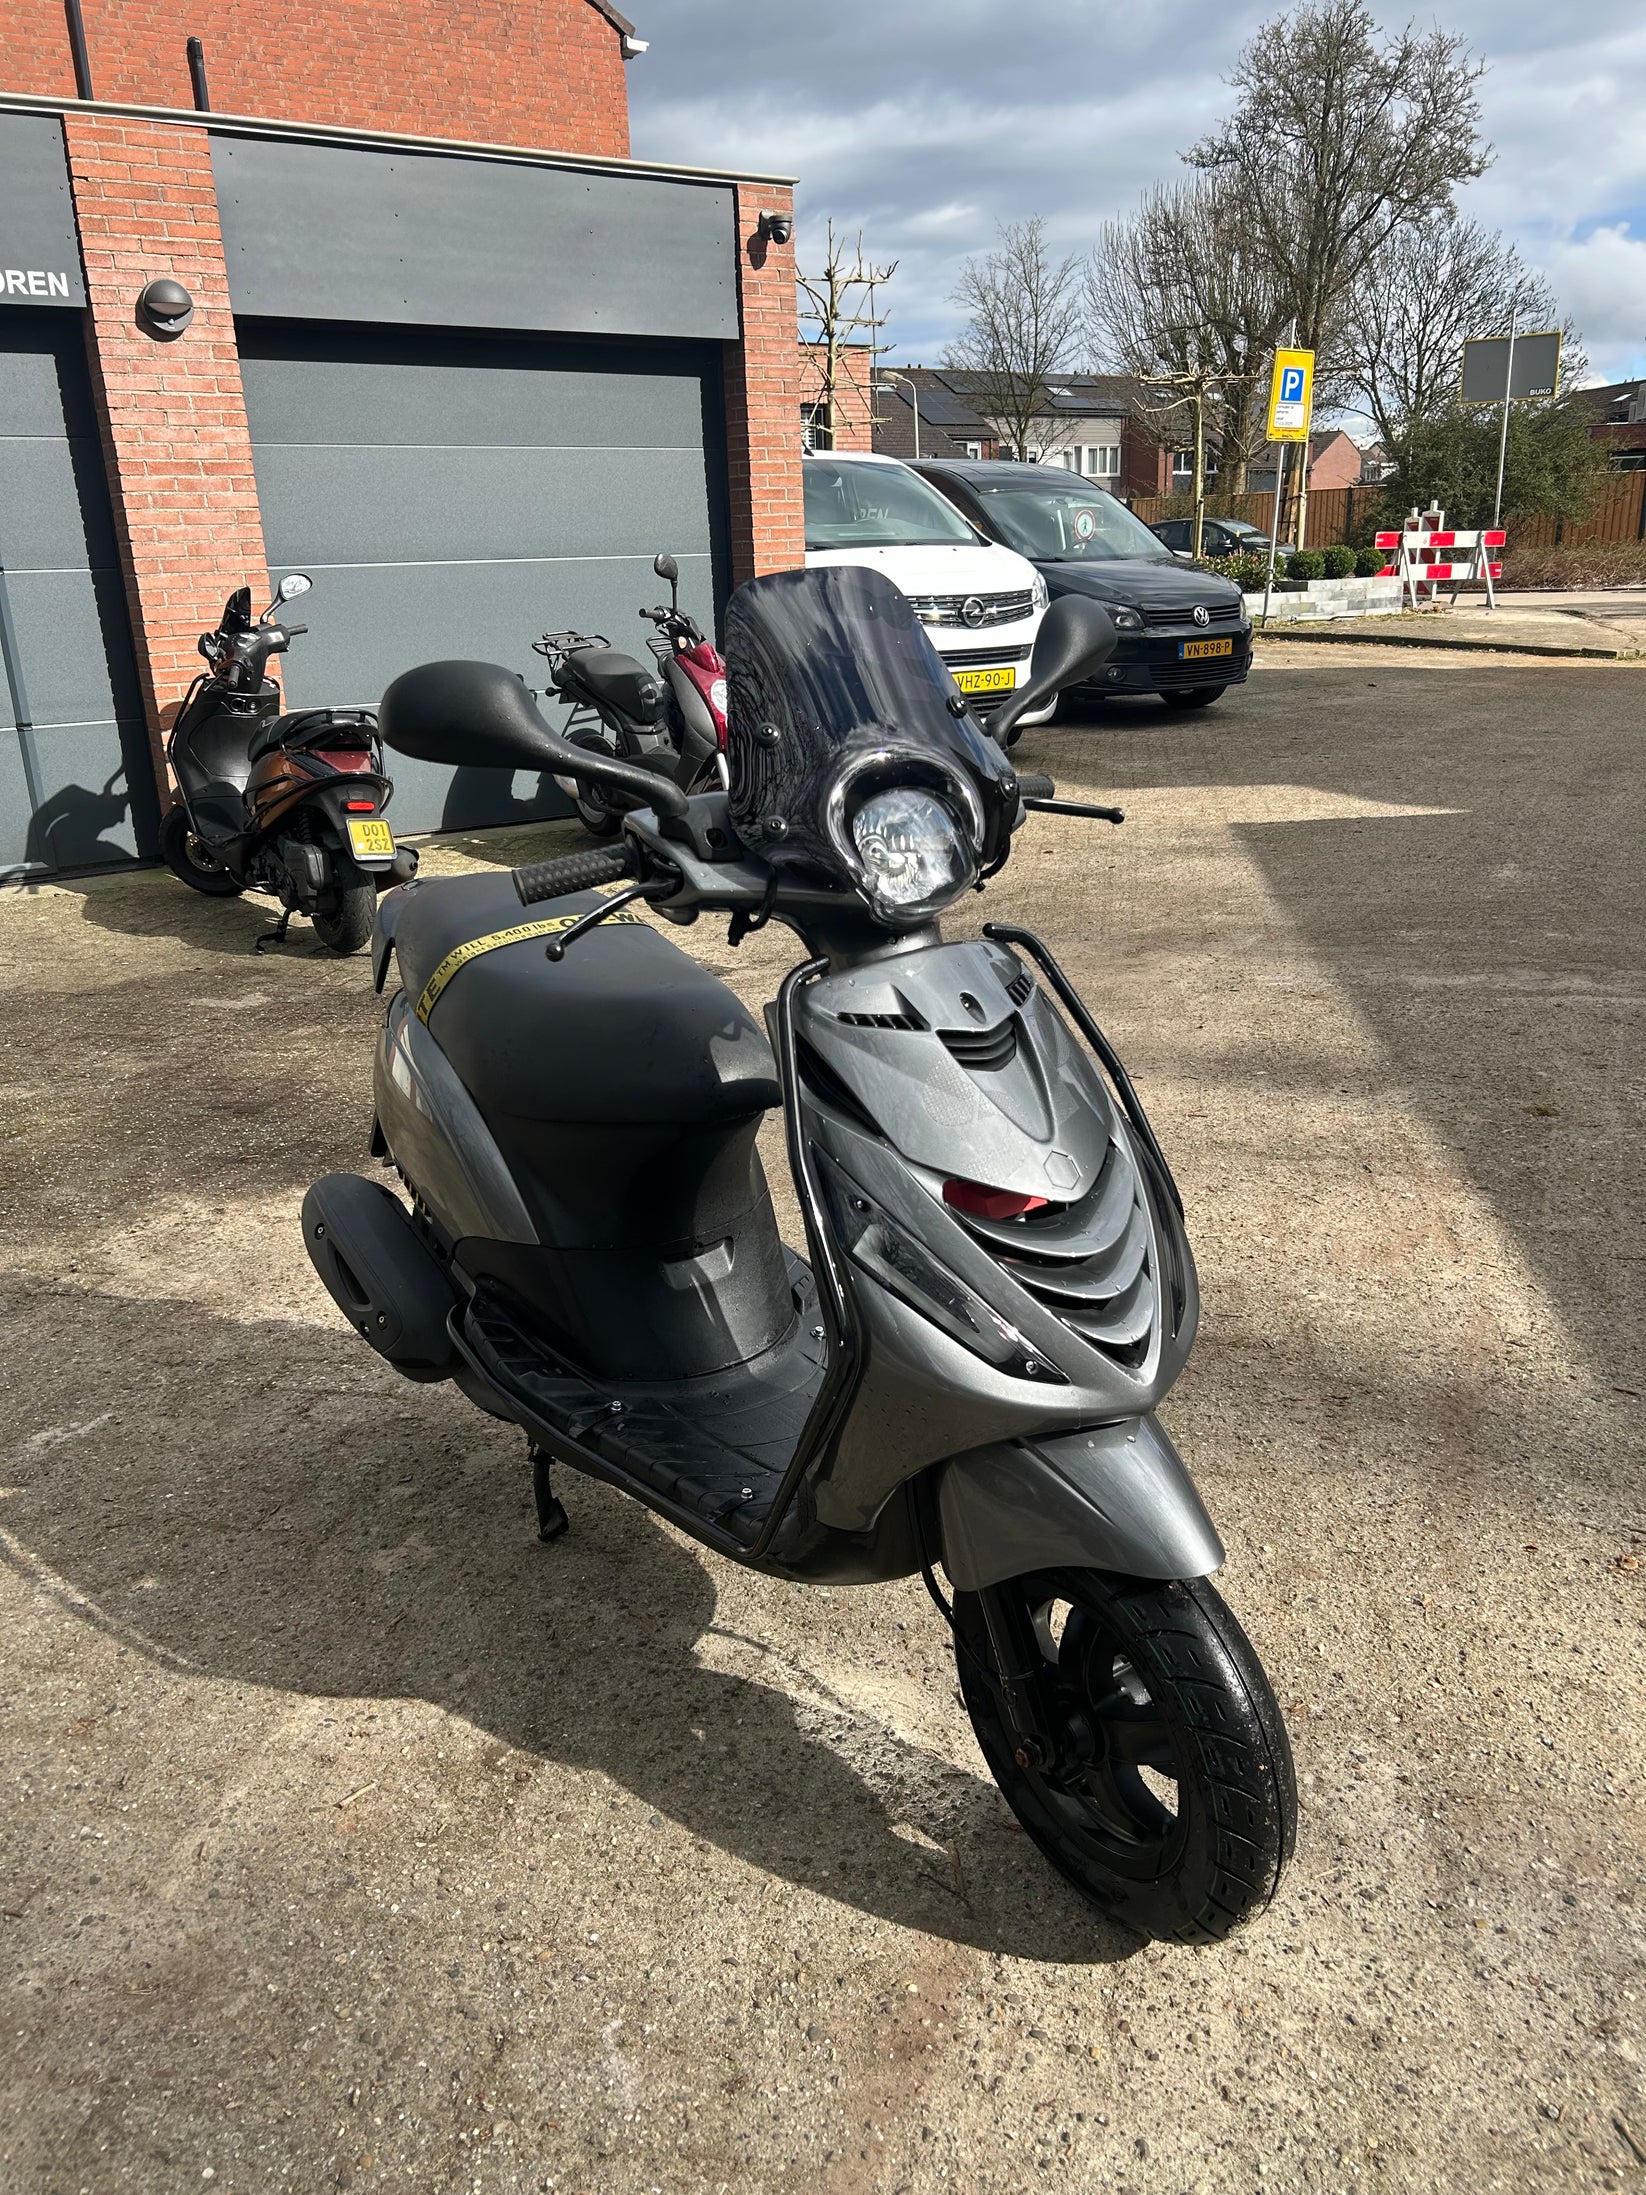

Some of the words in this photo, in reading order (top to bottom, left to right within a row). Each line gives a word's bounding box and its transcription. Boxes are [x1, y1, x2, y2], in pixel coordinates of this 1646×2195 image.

[0, 269, 70, 297] REN
[1284, 371, 1300, 399] P
[1529, 387, 1552, 396] BUKO
[1186, 641, 1230, 657] VN-898-P
[957, 672, 1010, 689] VHZ-90-J
[366, 838, 391, 851] 2SZ
[450, 940, 487, 960] WILL
[533, 922, 555, 931] lbs
